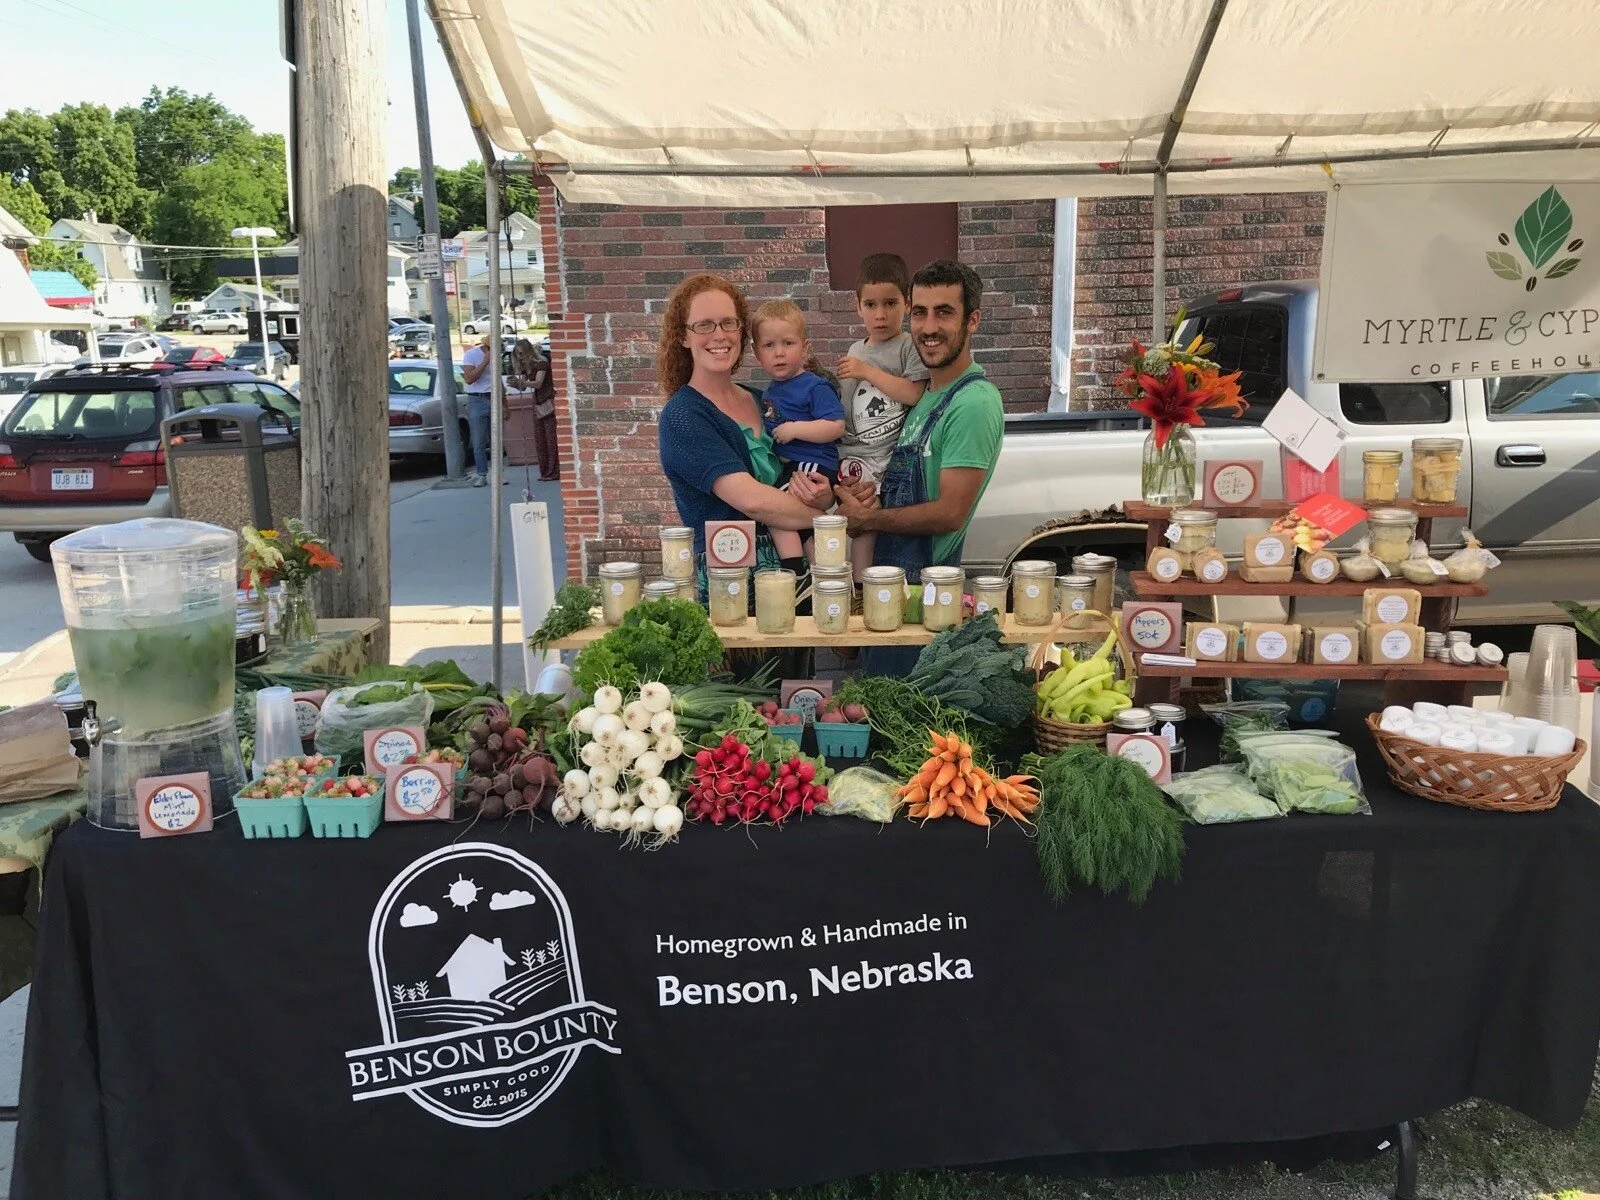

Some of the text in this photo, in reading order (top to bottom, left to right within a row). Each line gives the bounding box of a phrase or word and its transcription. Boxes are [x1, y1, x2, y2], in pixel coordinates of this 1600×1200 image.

[1362, 317, 1497, 344] MYRTLE
[1504, 310, 1532, 345] &
[1411, 354, 1600, 376] COFFEEHOU
[163, 800, 186, 811] Mint
[656, 911, 968, 958] Homegrown & Handmade in
[656, 951, 974, 1007] Benson, Nebraska
[348, 1011, 618, 1087] BENSON BOUNTY
[443, 1064, 550, 1097] SIMPLY GOOD
[472, 1088, 528, 1109] Est. 2015
